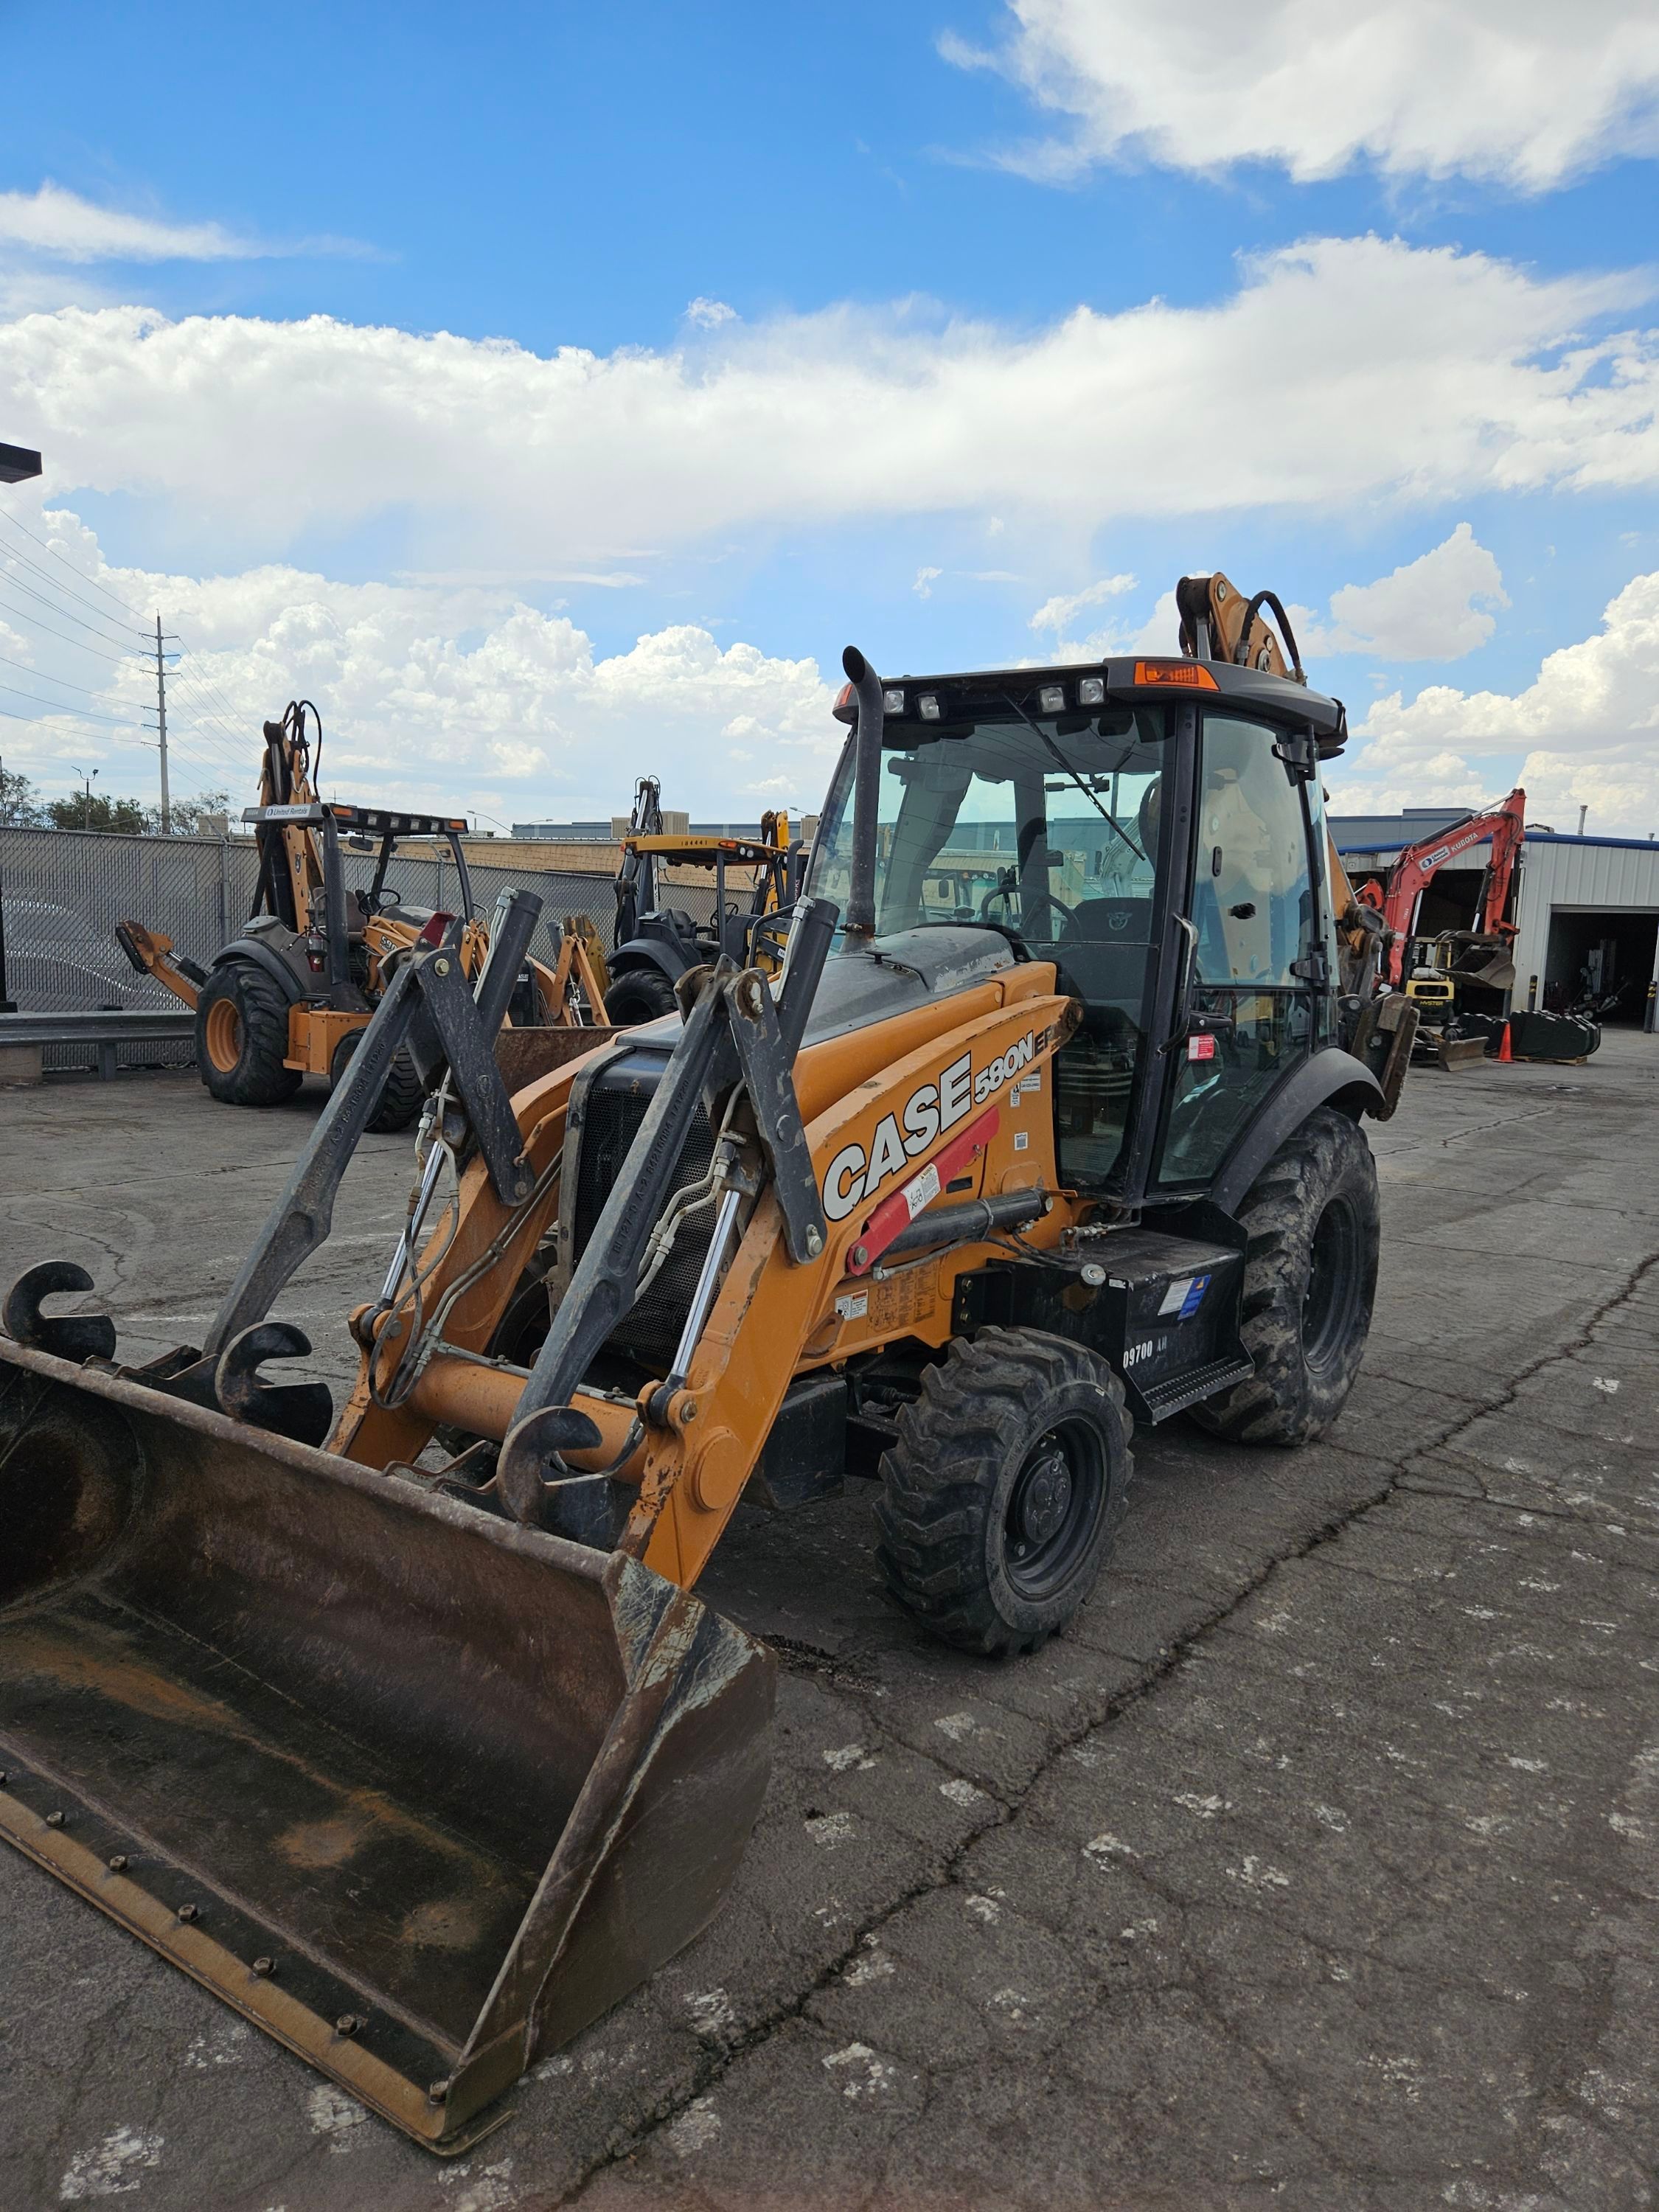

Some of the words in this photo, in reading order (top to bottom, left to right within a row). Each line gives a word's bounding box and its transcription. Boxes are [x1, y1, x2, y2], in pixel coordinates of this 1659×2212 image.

[1450, 832, 1478, 852] KUBOTA
[821, 1051, 973, 1222] CASE
[974, 1029, 1034, 1105] 580N
[1123, 1340, 1153, 1369] 09700
